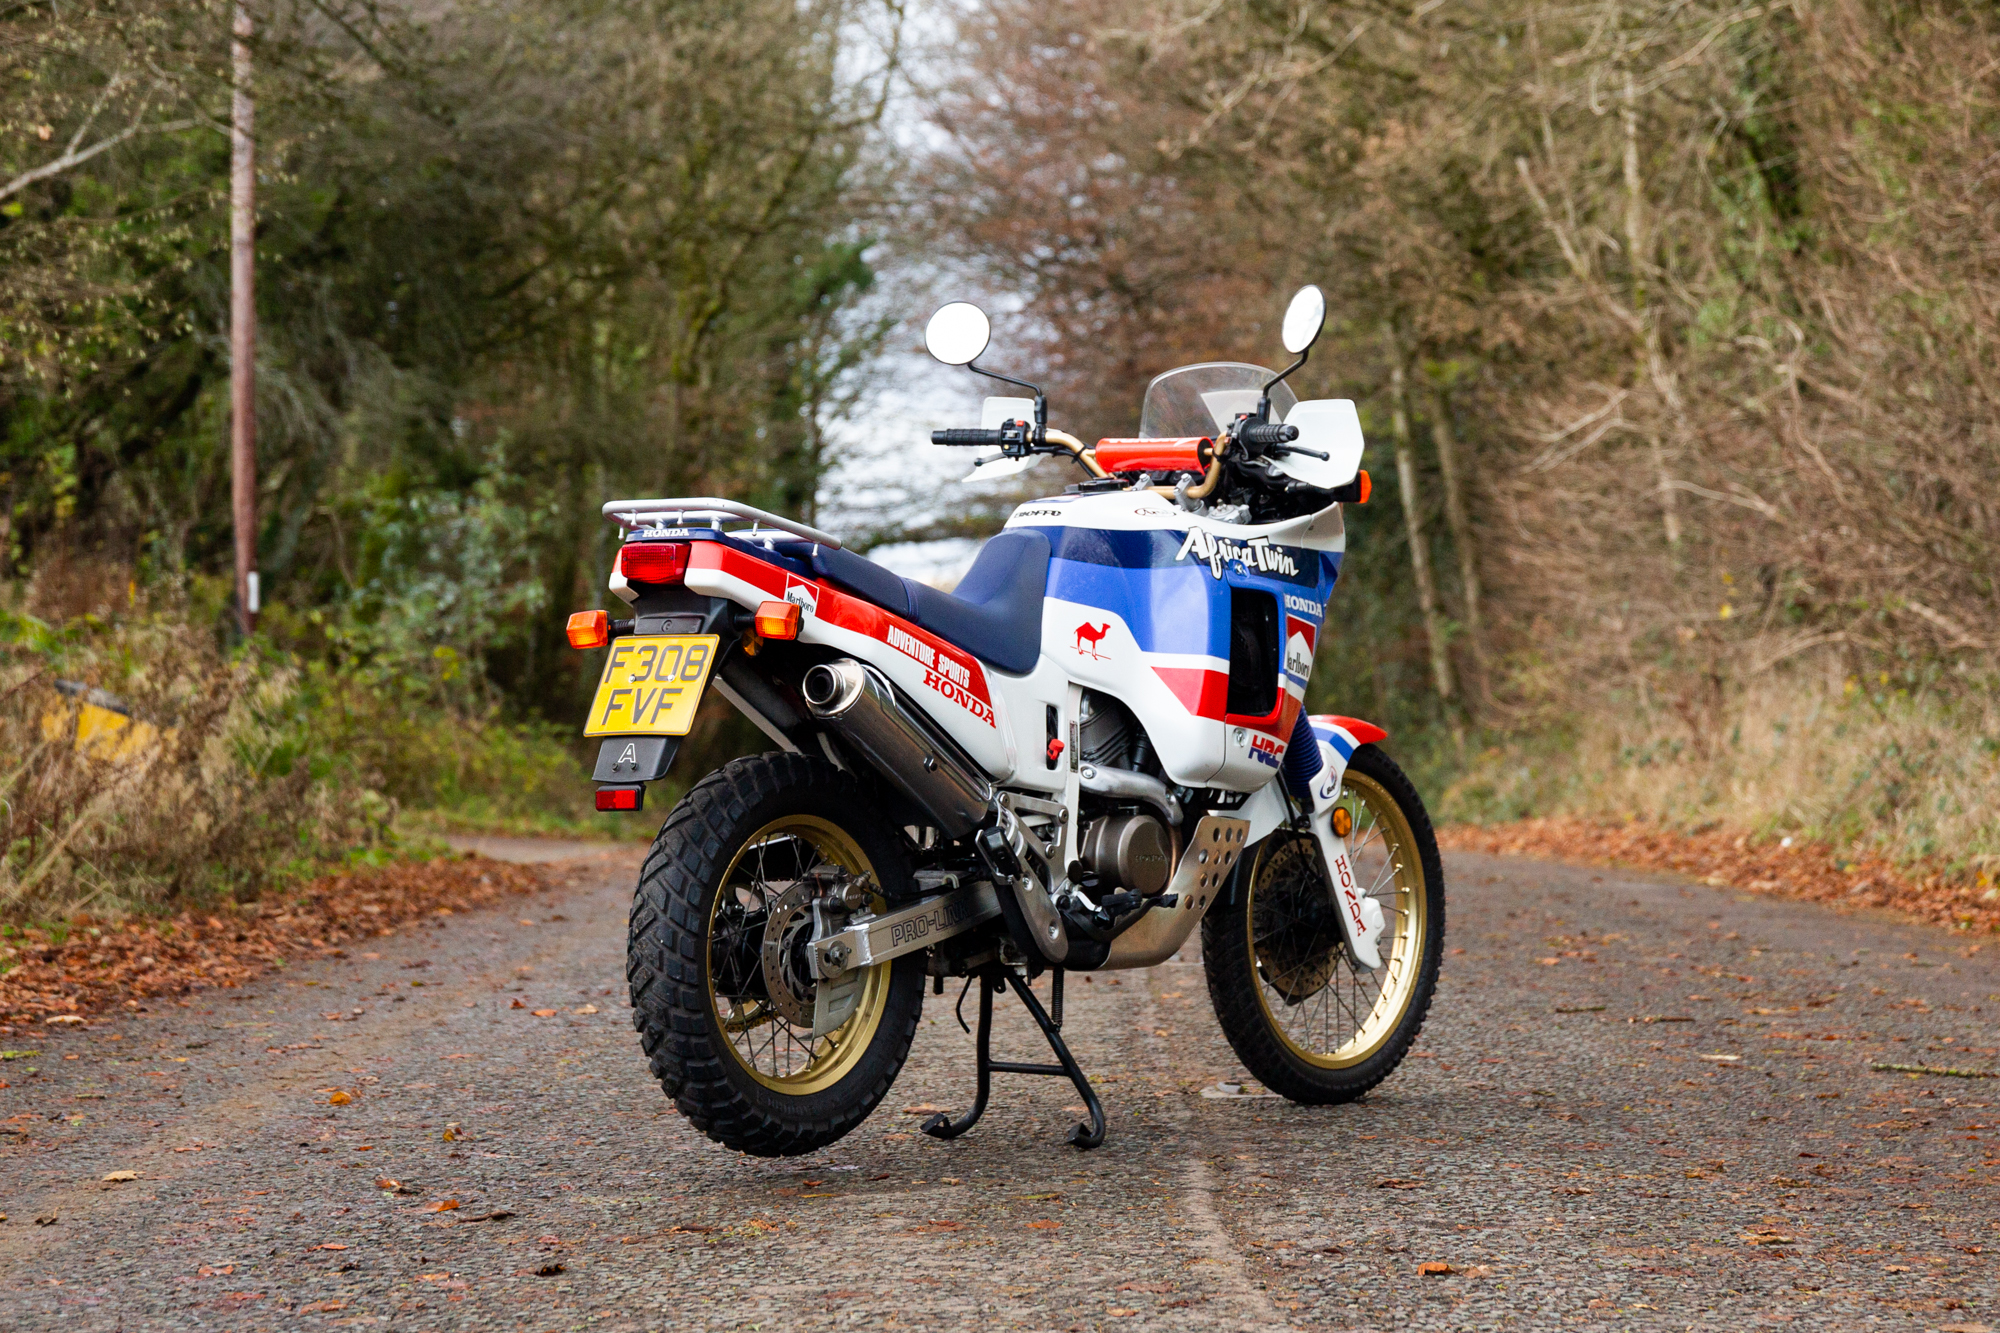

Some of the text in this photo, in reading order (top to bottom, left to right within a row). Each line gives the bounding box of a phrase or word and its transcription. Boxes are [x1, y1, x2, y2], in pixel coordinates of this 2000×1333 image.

[642, 528, 690, 538] HONDA
[1175, 526, 1300, 580] Africa Twin
[786, 590, 815, 613] Marlboro
[604, 644, 710, 684] F308
[886, 624, 970, 689] ADVENTURE SPORTS
[601, 687, 684, 726] FVF
[923, 669, 997, 729] HONDA
[617, 742, 637, 764] A
[1248, 734, 1285, 770] HRC
[1334, 854, 1367, 937] HONDA
[891, 900, 971, 947] PRO-LINK
